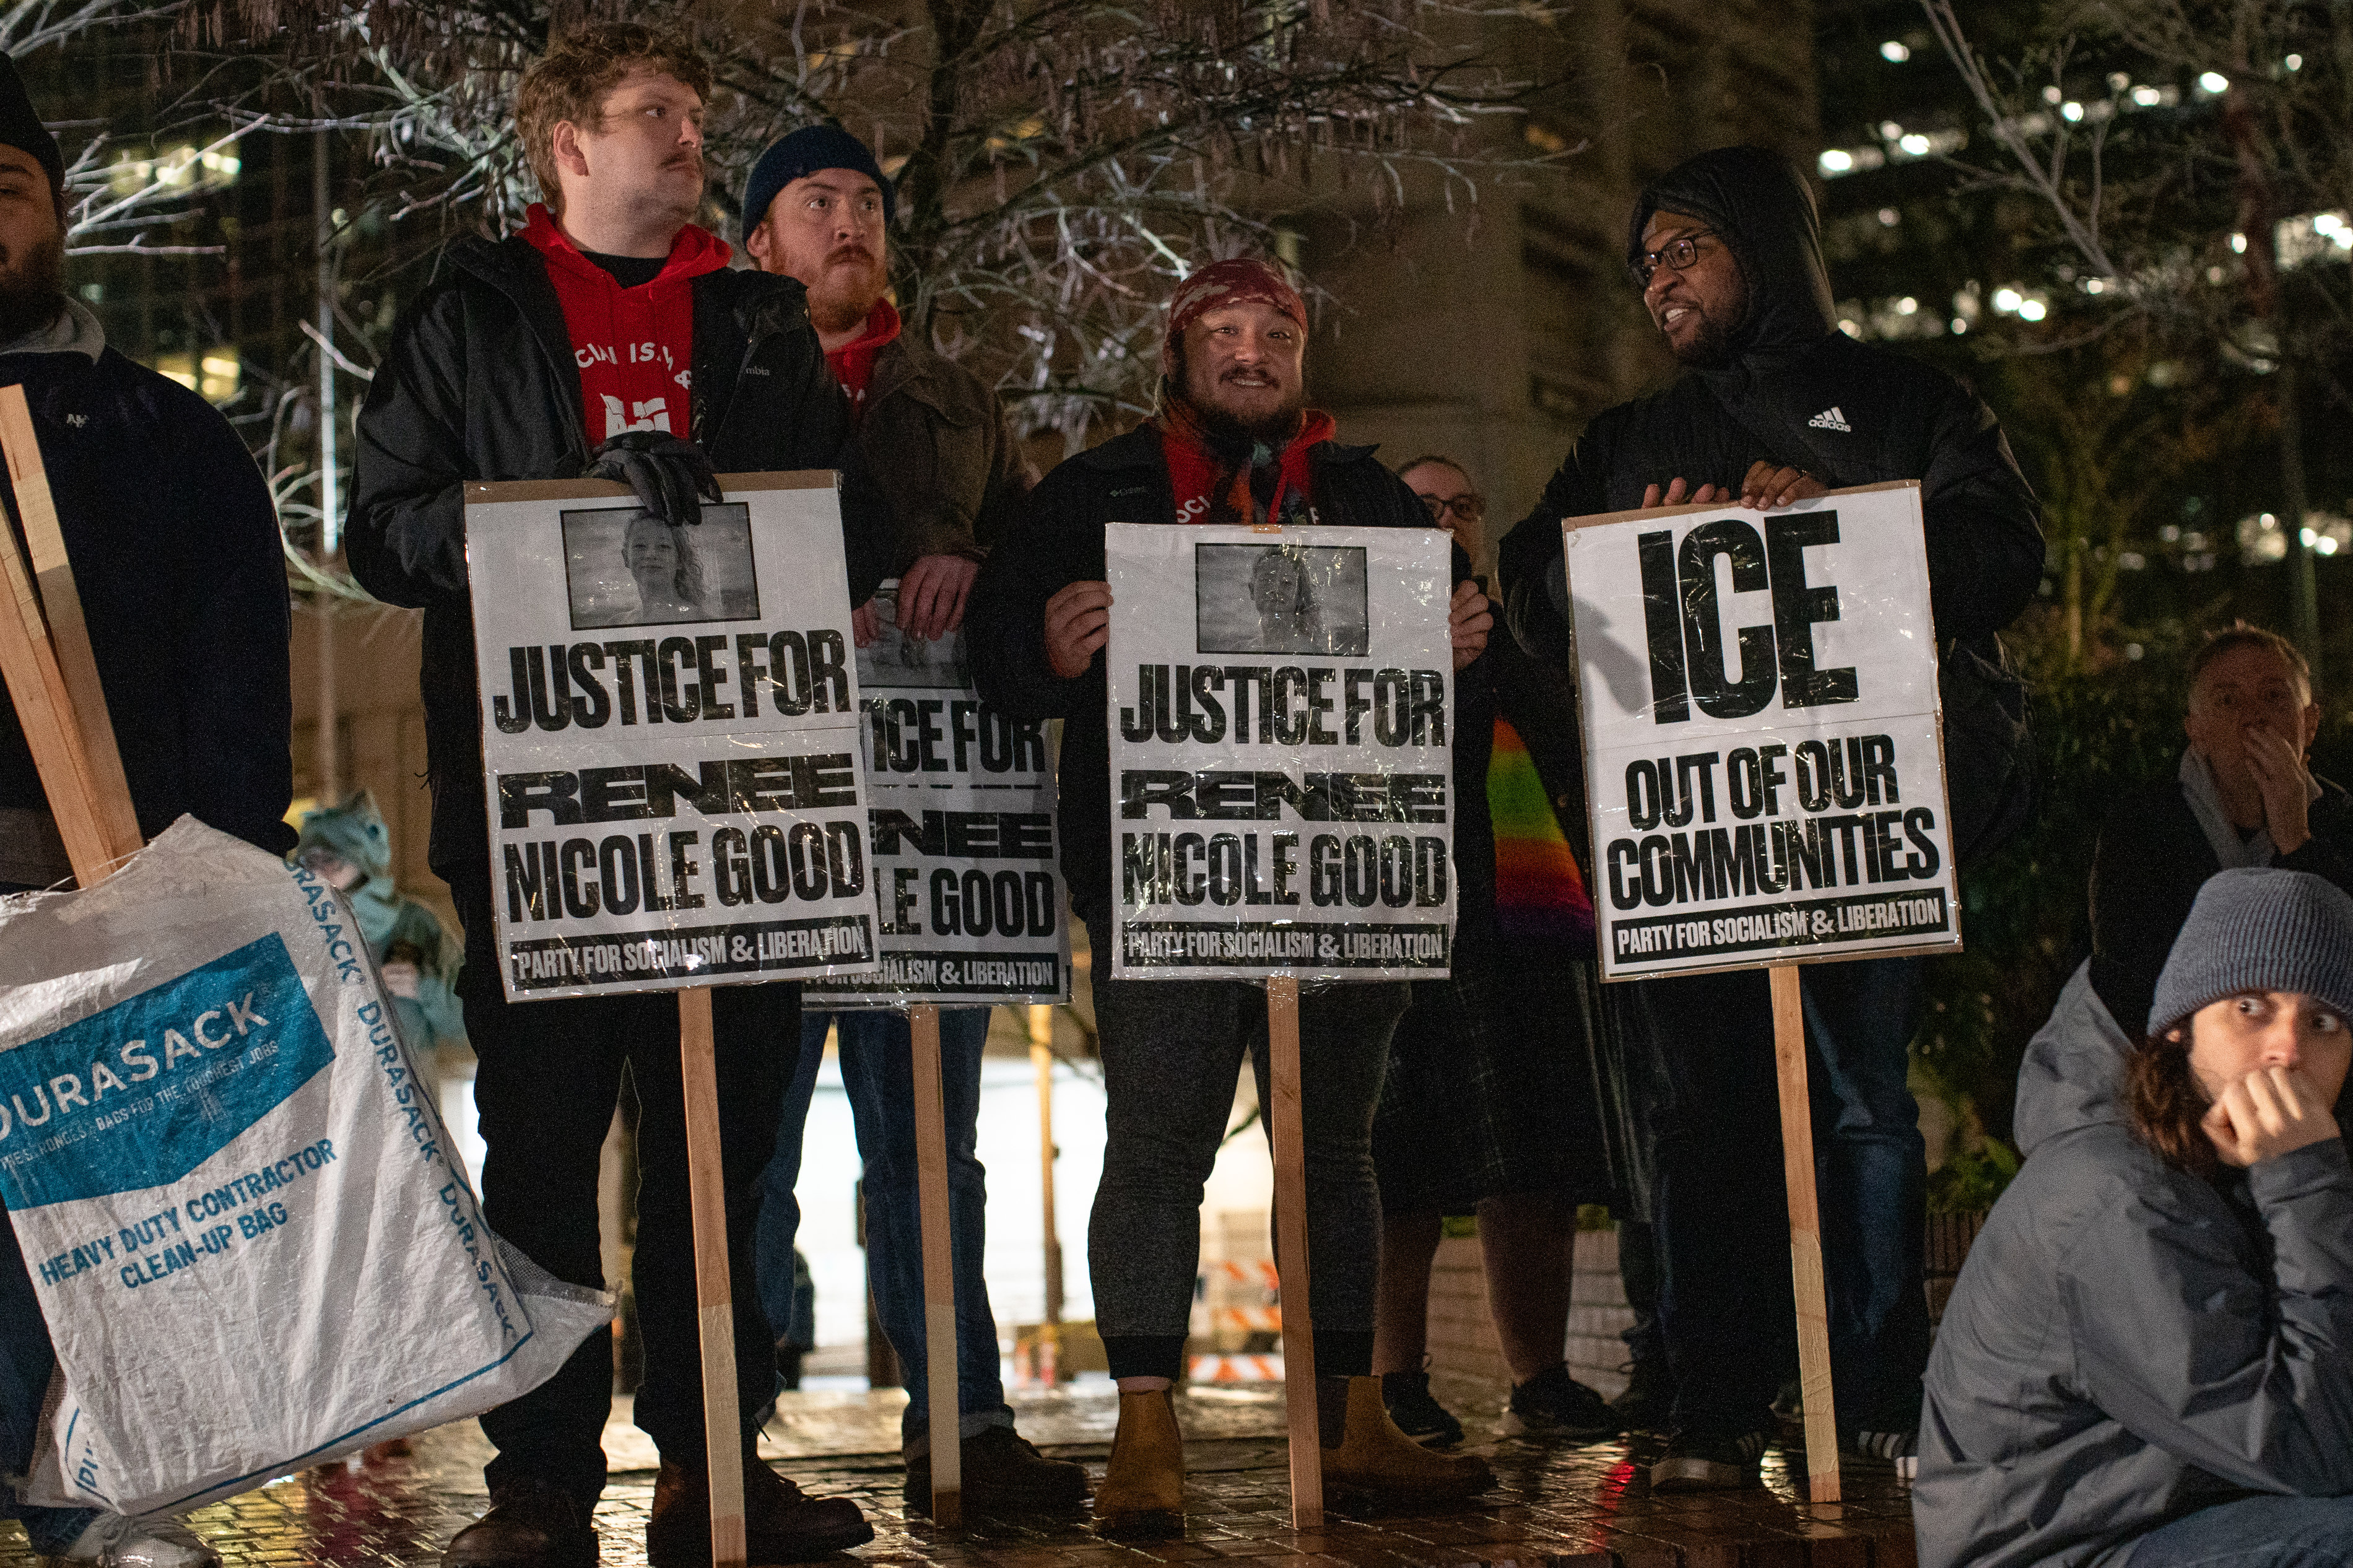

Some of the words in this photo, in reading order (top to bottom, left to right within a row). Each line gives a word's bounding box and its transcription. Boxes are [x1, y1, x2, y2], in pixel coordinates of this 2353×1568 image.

[1808, 419, 1851, 432] adidas
[1637, 509, 1859, 725] ICE
[493, 634, 735, 734] JUSTICE
[736, 629, 853, 718] FOR
[1120, 664, 1339, 745] JUSTICE
[1344, 668, 1446, 747] FOR
[950, 700, 1046, 773] FOR
[497, 754, 858, 829] RENEE
[1121, 769, 1446, 824] RENEE
[1625, 751, 1719, 832] OUT
[1726, 744, 1790, 819] OF
[1795, 734, 1900, 813] OUR
[869, 809, 1053, 859] NEE
[1121, 832, 1300, 906] NICOLE
[1310, 834, 1446, 908] GOOD
[1607, 807, 1941, 911] COMMUNITIES
[504, 830, 706, 923] NICOLE
[712, 821, 865, 907] GOOD
[931, 868, 1056, 938] GOOD
[517, 946, 584, 980] PARTY
[584, 943, 622, 973] FOR
[623, 934, 727, 972] SOCIALISM
[731, 936, 755, 961] &
[759, 925, 866, 958] LIBERATION
[1128, 931, 1185, 958] PARTY
[1186, 931, 1224, 957] FOR
[1224, 931, 1315, 958] SOCIALISM
[1318, 933, 1341, 959] &
[1344, 932, 1443, 959] LIBERATION
[1618, 927, 1673, 955] PARTY
[1676, 922, 1711, 948] FOR
[1713, 910, 1808, 945] SOCIALISM
[1811, 910, 1835, 934] &
[1838, 897, 1941, 932] LIBERATION
[940, 961, 961, 985] &
[964, 960, 1053, 985] LIBERATION
[95, 1108, 129, 1131] BAGS
[155, 1084, 181, 1105] THE
[249, 1040, 279, 1064] JOBS
[38, 1235, 115, 1287] HEAVY
[117, 1207, 181, 1253] DUTY
[186, 1138, 337, 1222] CONTRACTOR
[120, 1224, 233, 1289] CLEAN-UP
[237, 1201, 289, 1240] BAG
